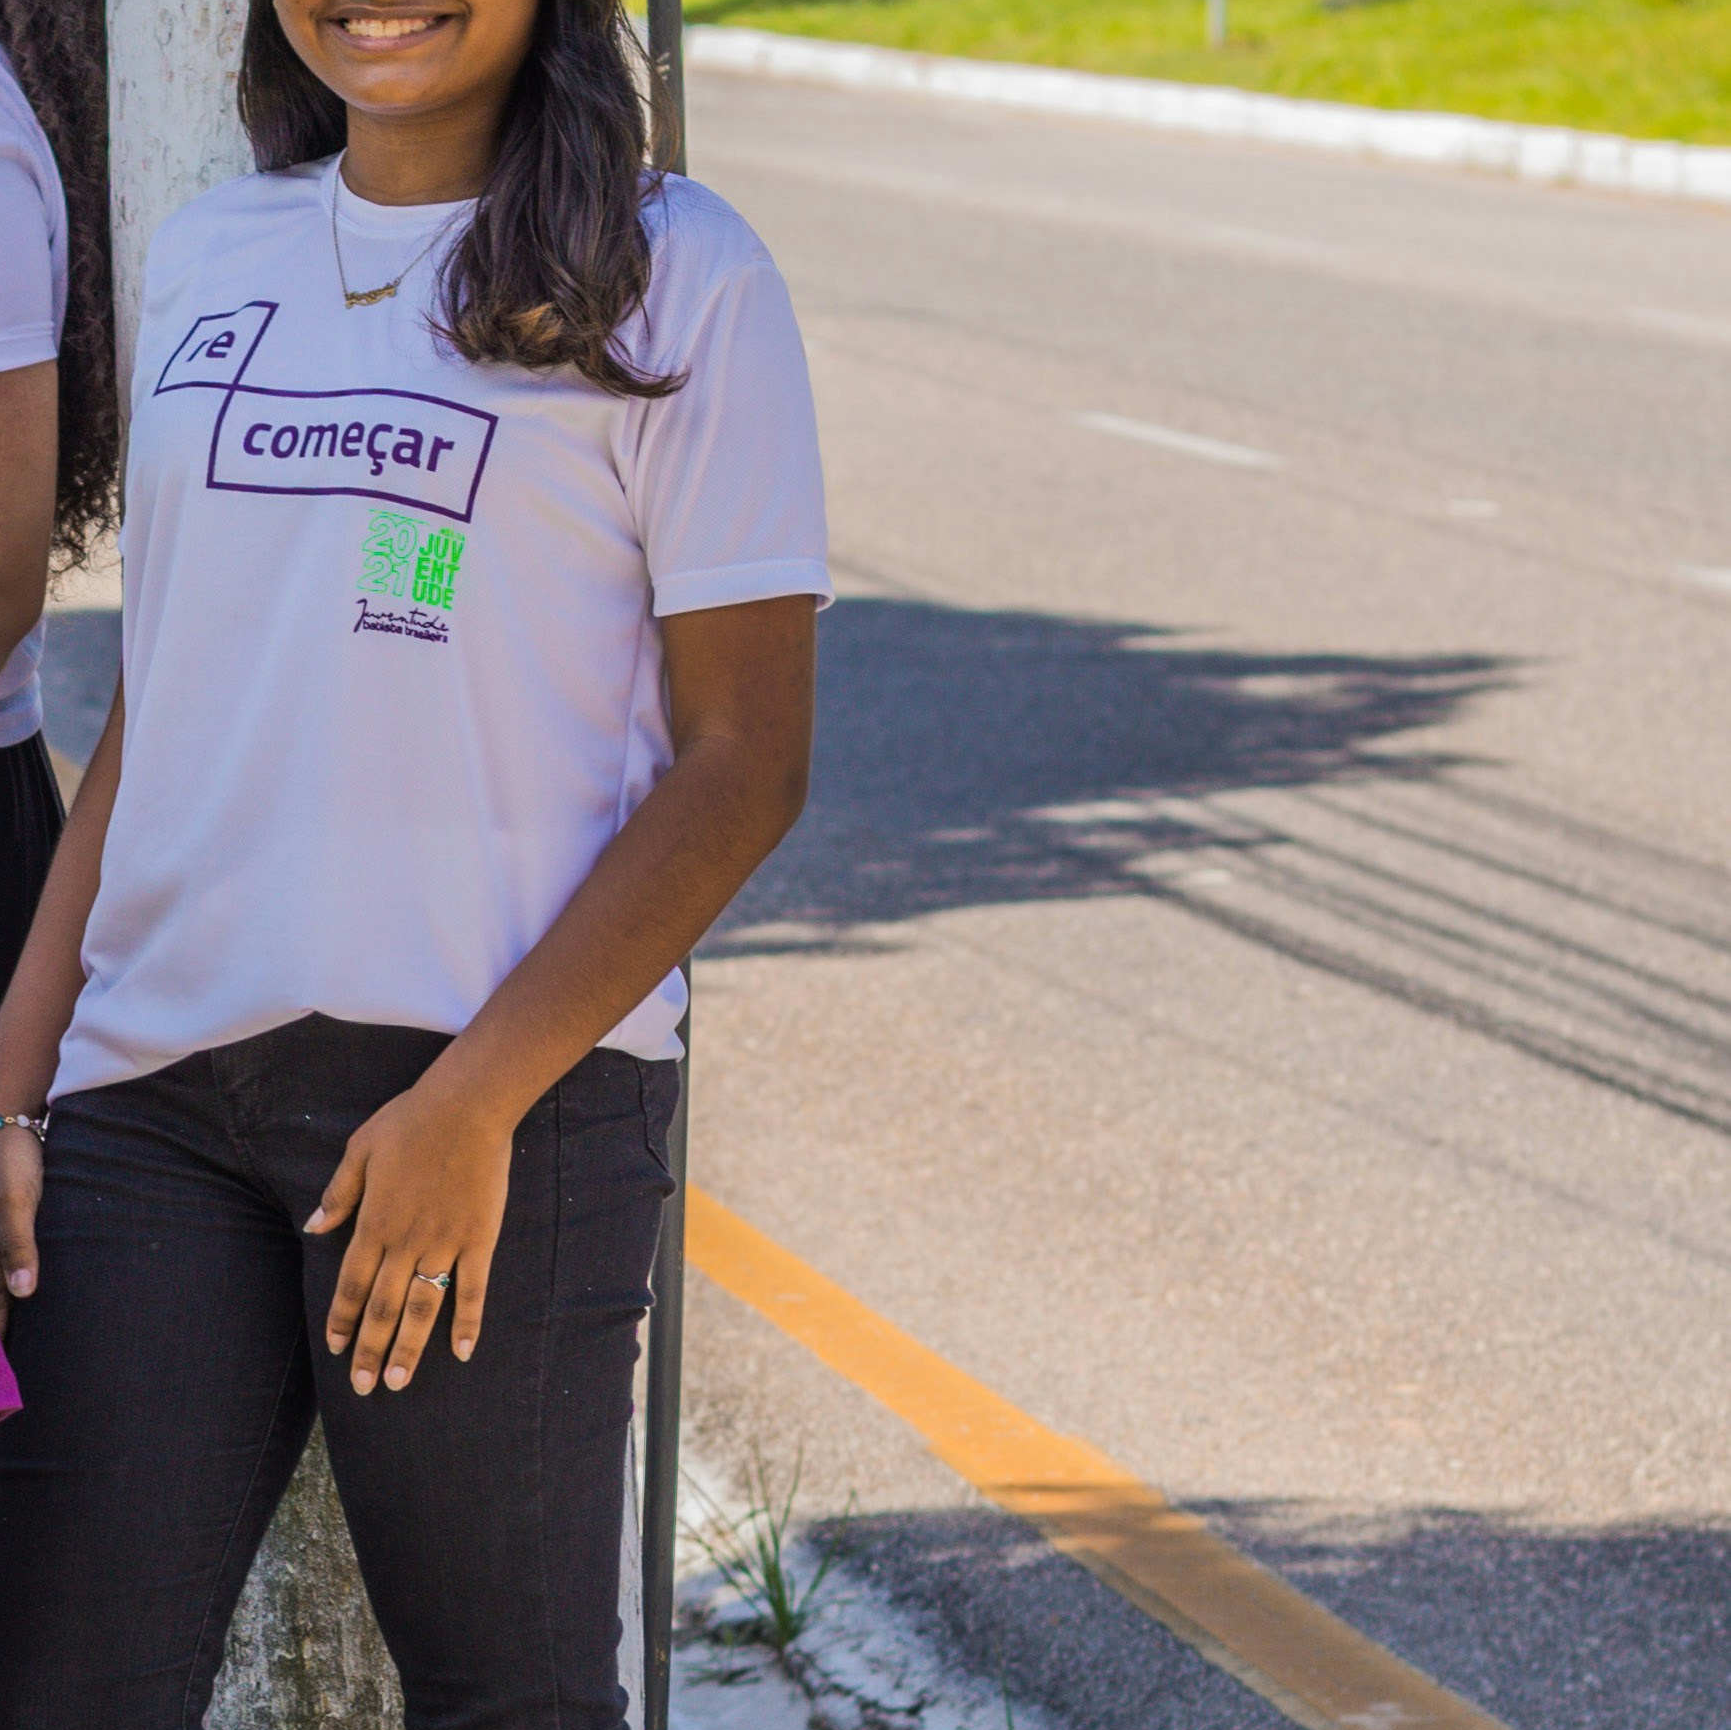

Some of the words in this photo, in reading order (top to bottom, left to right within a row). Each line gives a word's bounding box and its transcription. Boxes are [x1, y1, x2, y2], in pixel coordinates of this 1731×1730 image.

[186, 329, 236, 363] re
[242, 420, 455, 477] começar
[362, 515, 419, 559] 20
[419, 532, 464, 564] JUV
[356, 552, 410, 598] 21
[415, 555, 461, 588] ENT
[412, 579, 455, 611] UDE
[353, 597, 450, 633] Juventude
